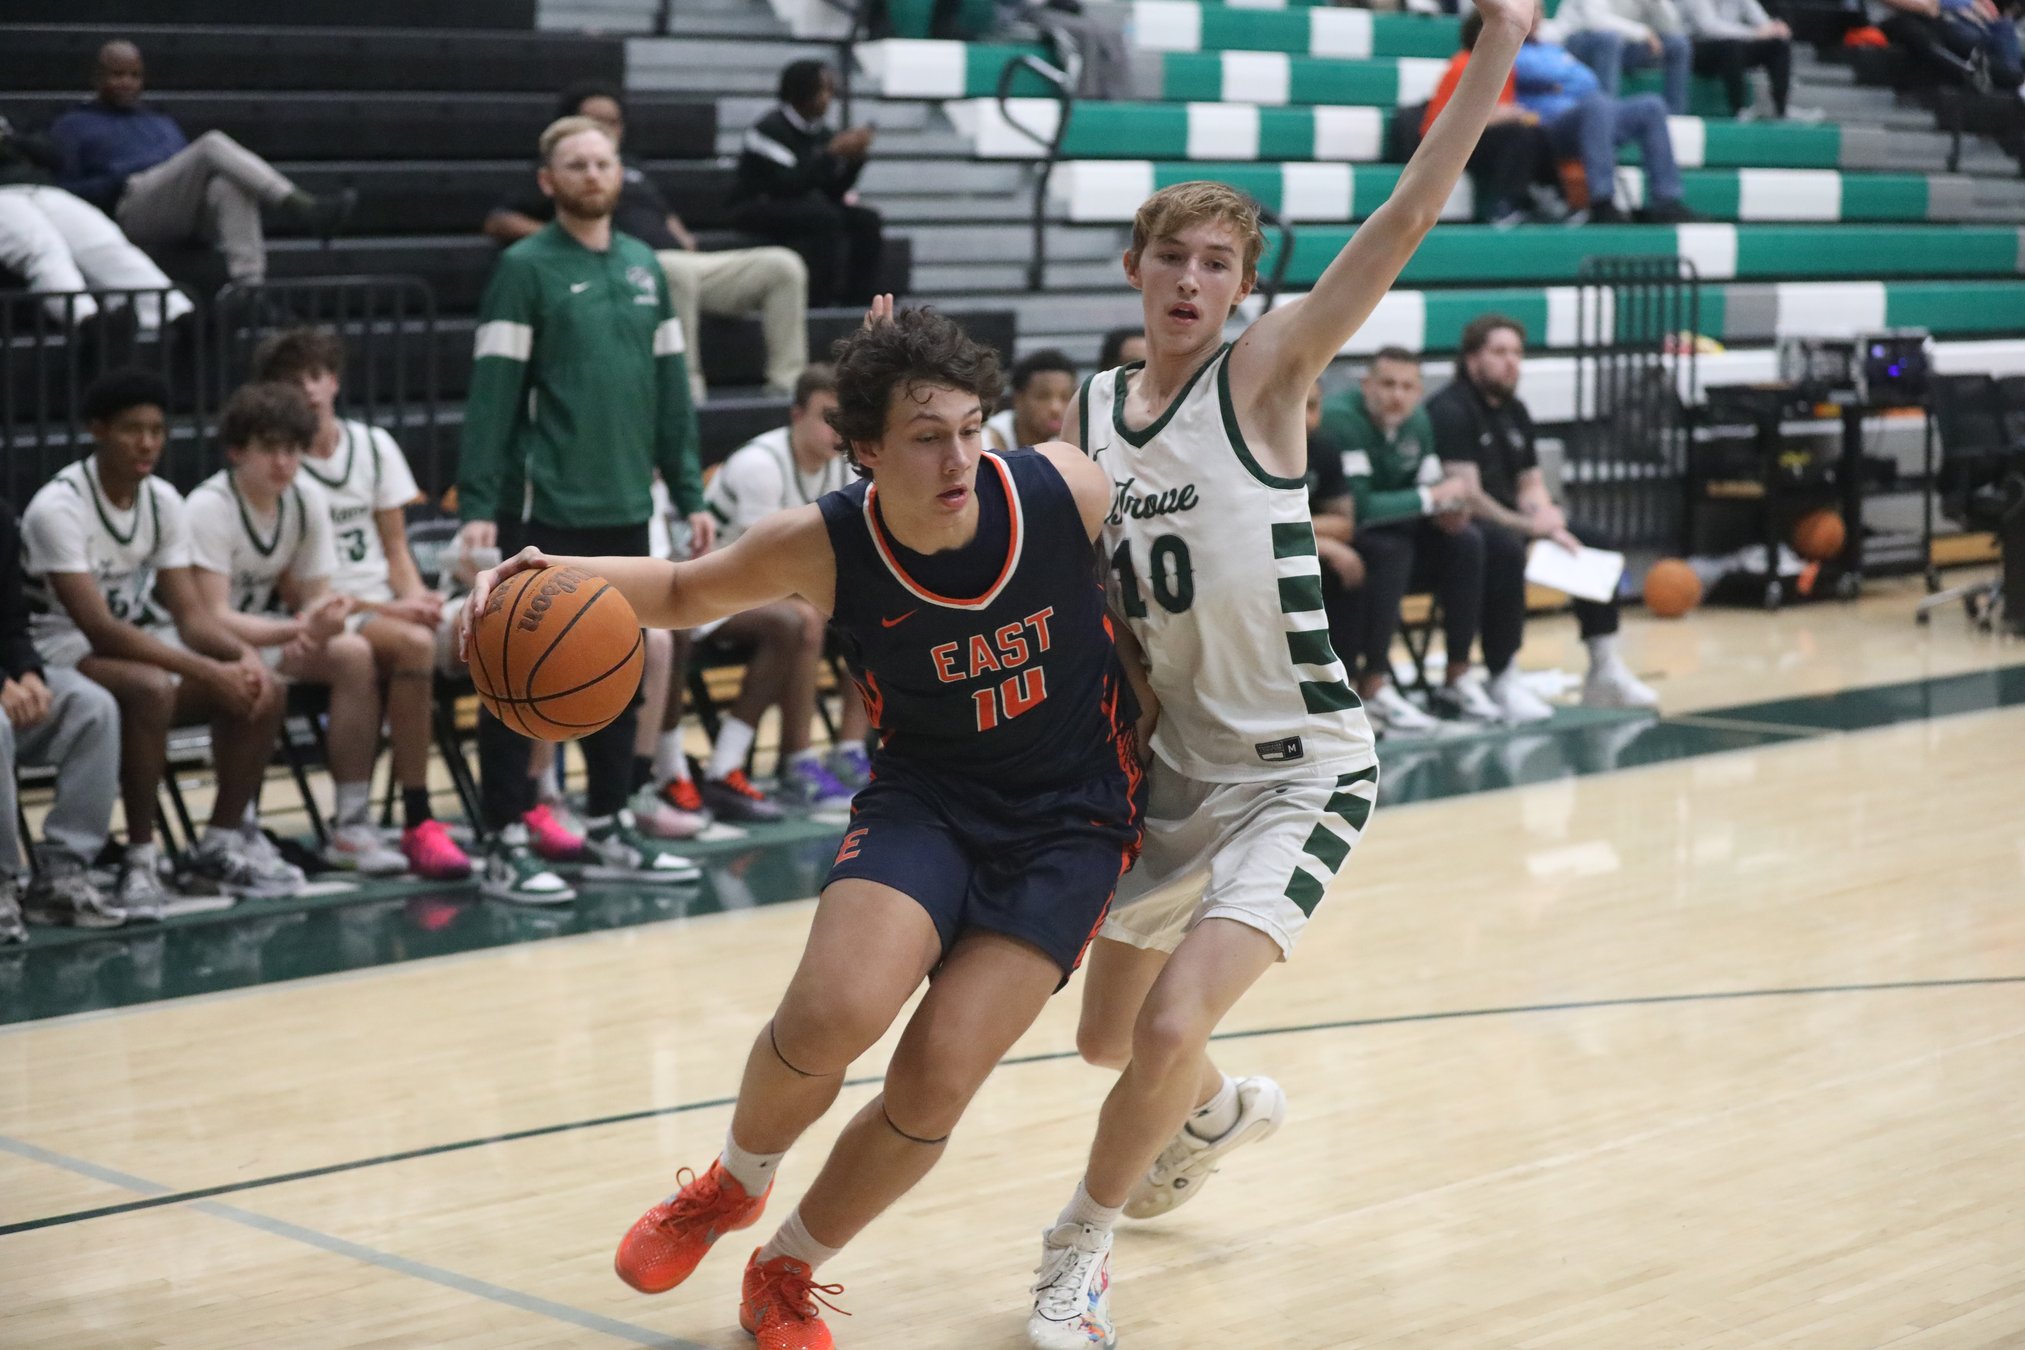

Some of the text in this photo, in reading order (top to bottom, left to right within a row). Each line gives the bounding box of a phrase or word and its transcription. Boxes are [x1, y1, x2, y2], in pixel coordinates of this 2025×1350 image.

[1111, 534, 1195, 618] 10
[930, 605, 1054, 683] EAST
[1287, 743, 1297, 753] M
[832, 827, 869, 868] E
